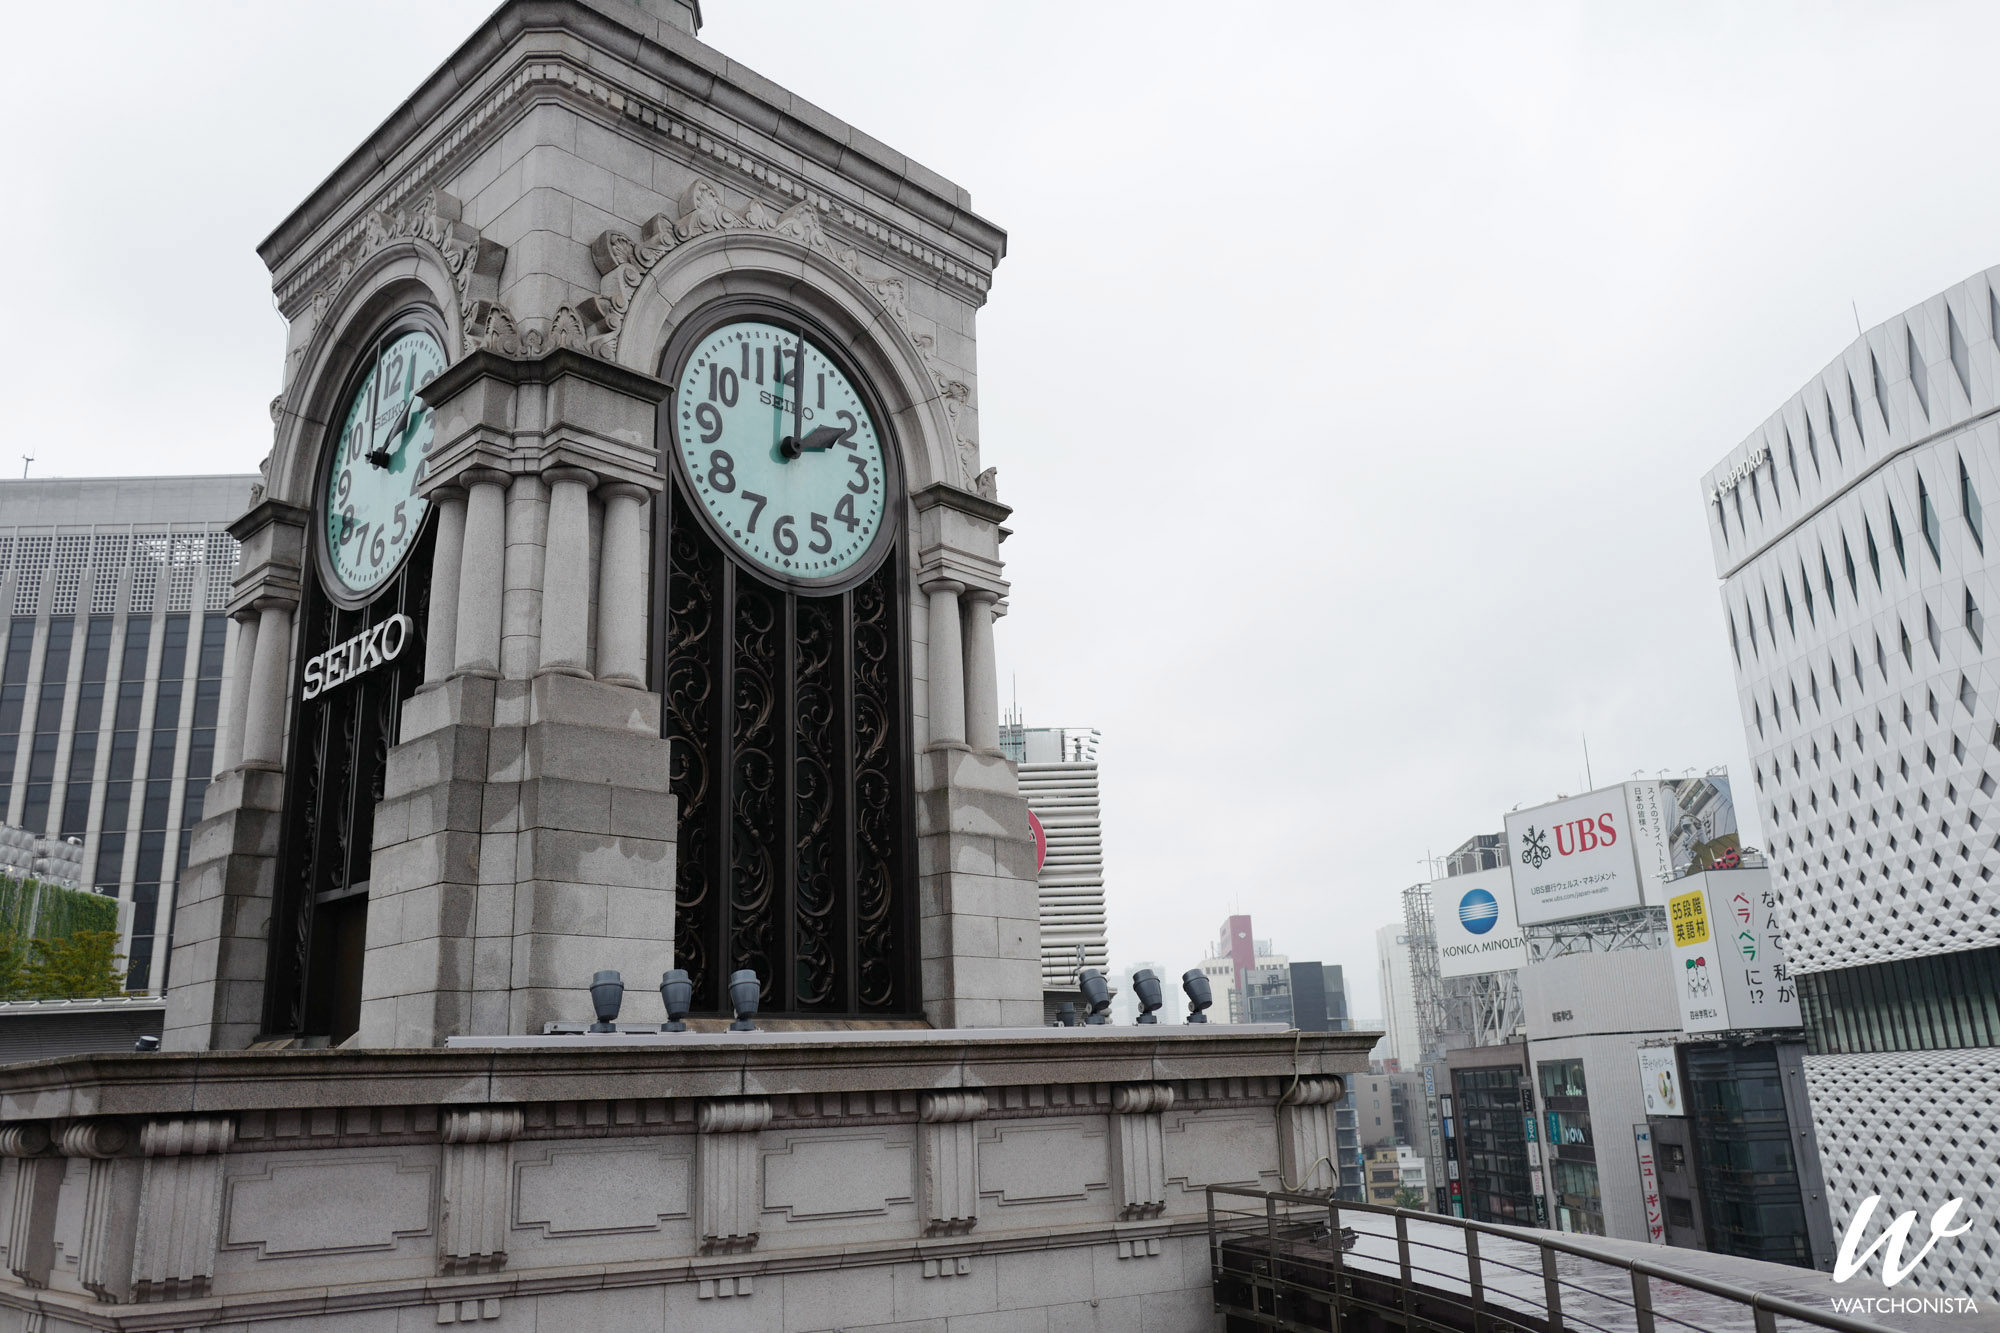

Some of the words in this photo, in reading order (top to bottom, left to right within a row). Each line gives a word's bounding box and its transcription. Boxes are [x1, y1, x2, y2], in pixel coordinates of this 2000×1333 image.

[383, 354, 403, 401] 12
[741, 342, 764, 385] 11
[708, 362, 739, 408] 10
[759, 390, 814, 420] SEIO
[817, 373, 825, 410] 1
[345, 422, 365, 466] 10
[695, 402, 723, 444] 9
[835, 410, 858, 450] 2
[338, 469, 352, 511] 9
[708, 449, 736, 494] 8
[847, 454, 870, 494] 3
[340, 504, 354, 546] 8
[391, 500, 407, 545] 5
[741, 490, 767, 534] 7
[808, 512, 833, 554] 5
[834, 493, 860, 533] 4
[355, 522, 370, 567] 7
[370, 523, 385, 567] 6
[773, 515, 799, 555] 6
[302, 613, 408, 701] SEIKO
[1553, 812, 1617, 857] UBS
[1442, 943, 1480, 957] KONICA
[1482, 937, 1526, 952] MINOLTA
